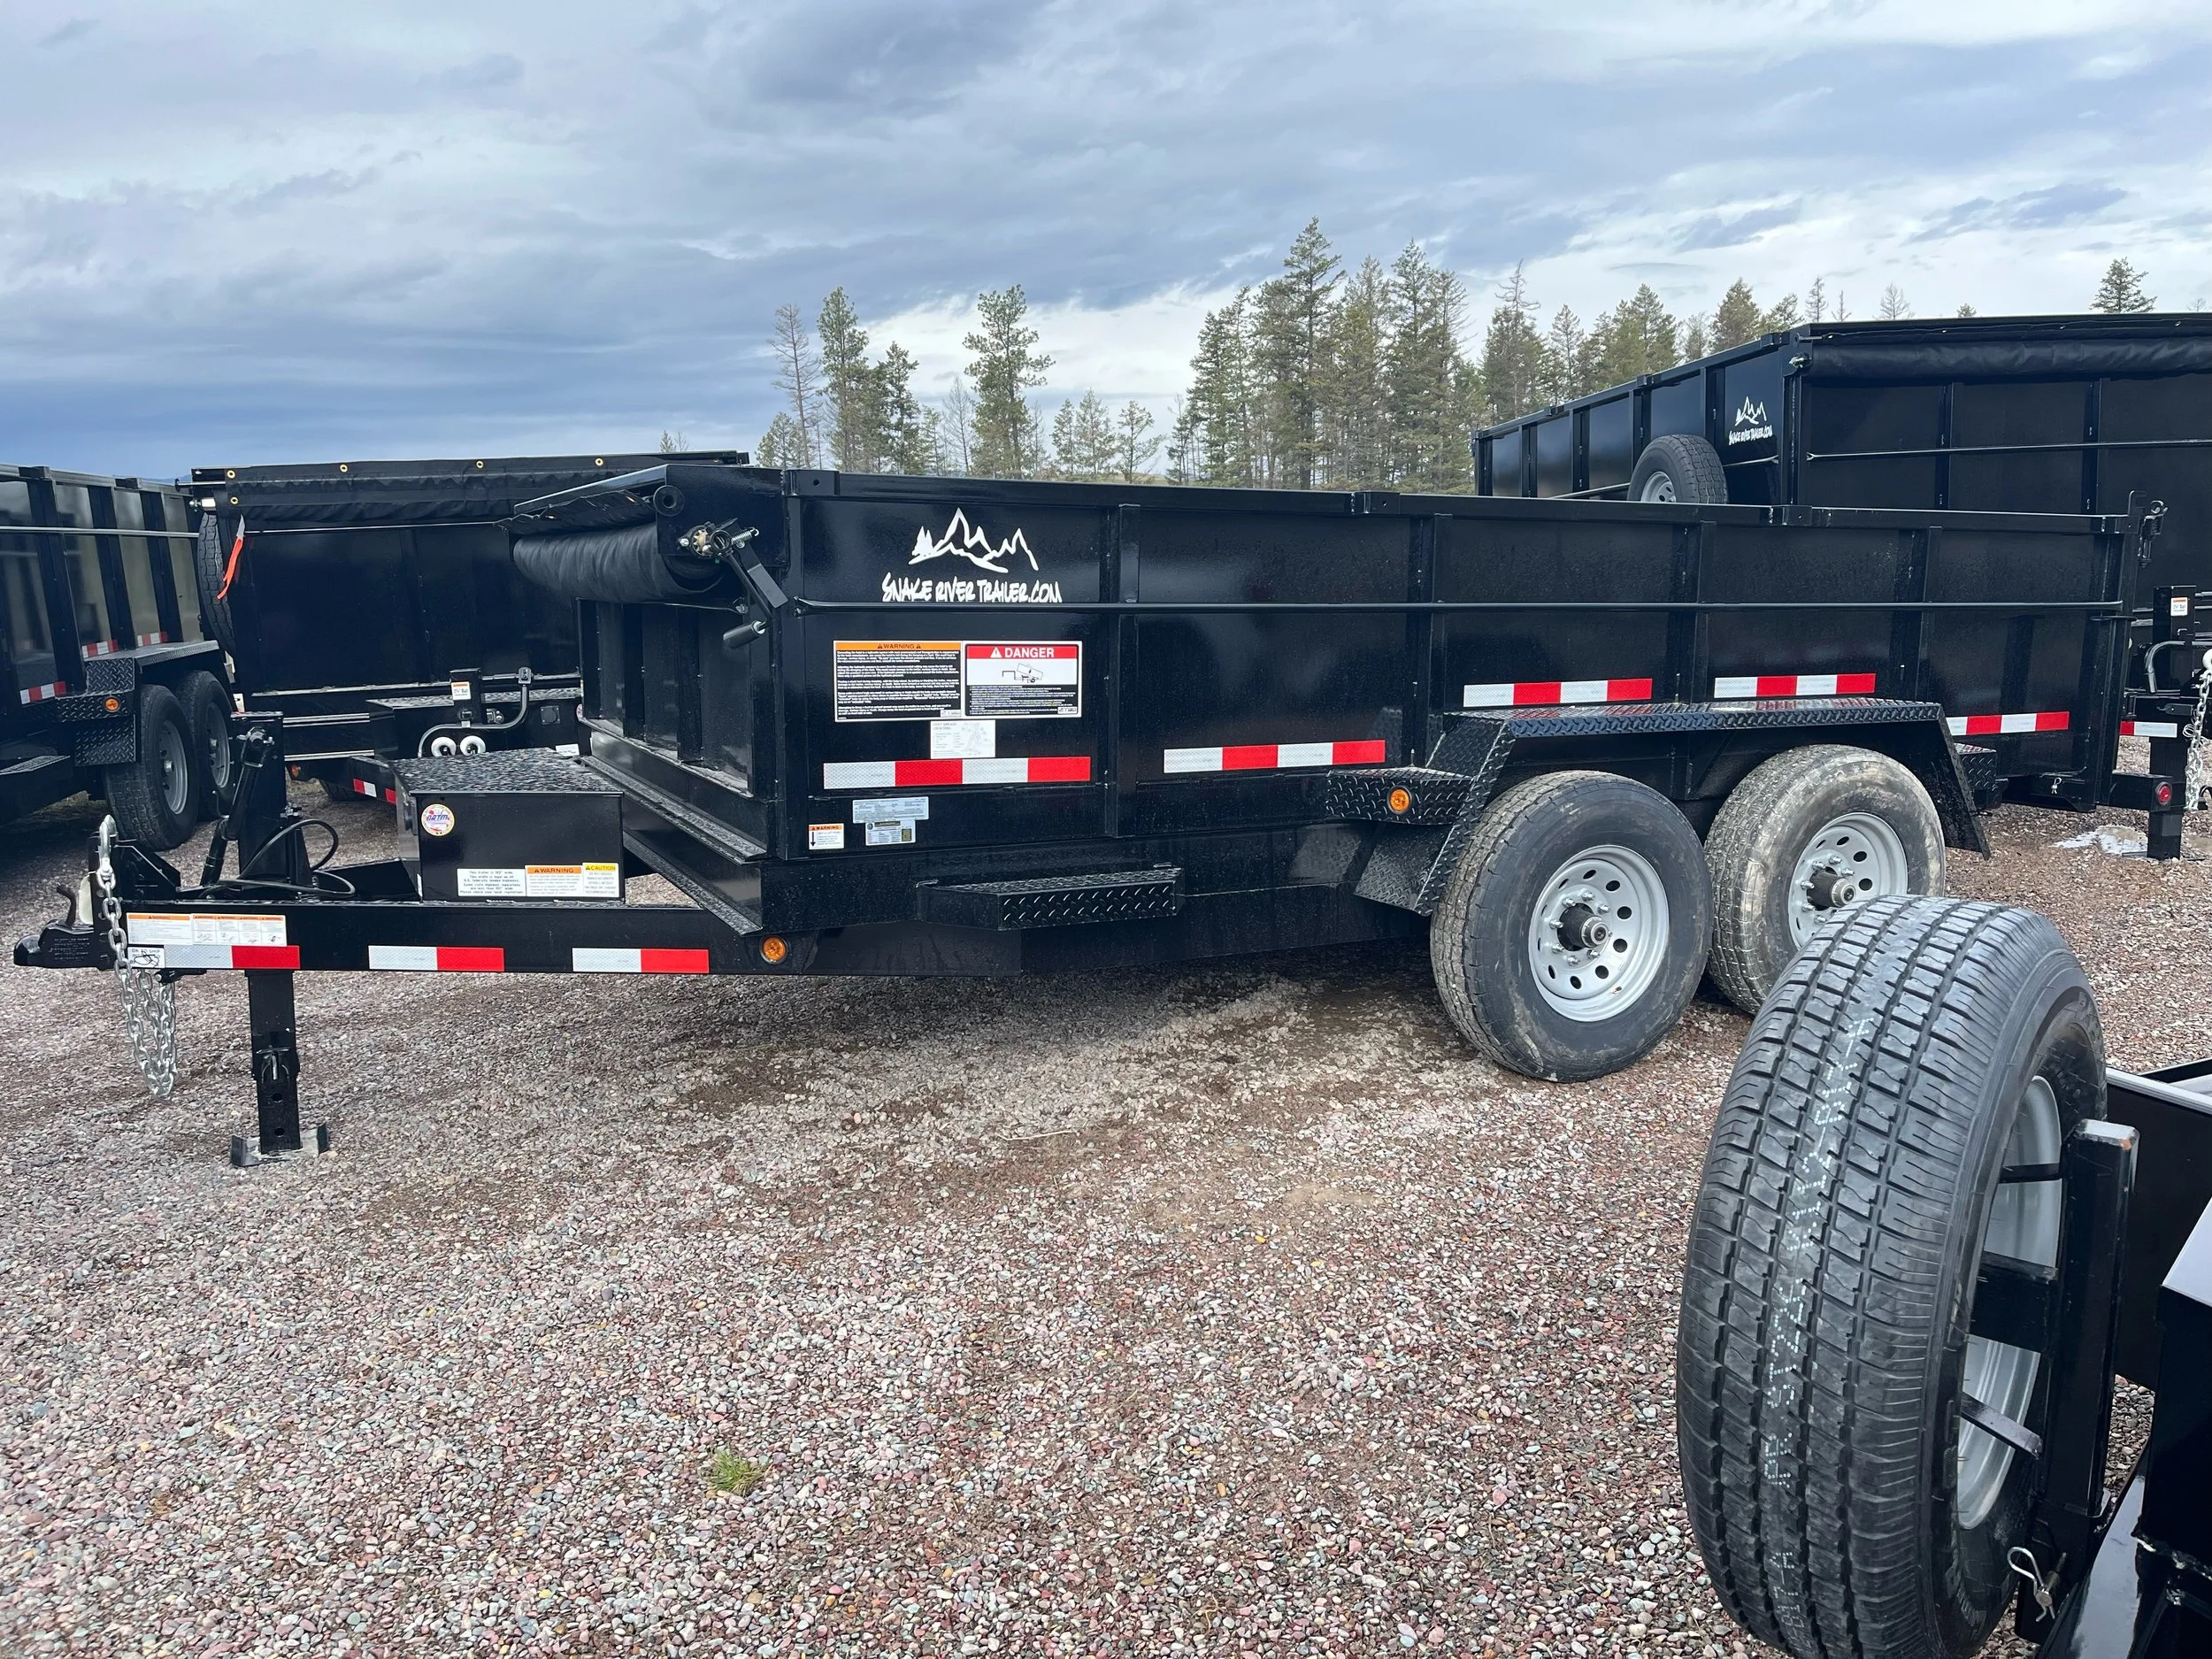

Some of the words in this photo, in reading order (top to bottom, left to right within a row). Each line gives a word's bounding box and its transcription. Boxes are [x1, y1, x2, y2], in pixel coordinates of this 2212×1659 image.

[882, 572, 933, 602] SNAKE
[935, 576, 975, 602] RIVER
[977, 579, 1063, 603] TRAILER.COM
[1004, 647, 1055, 658] DANGER
